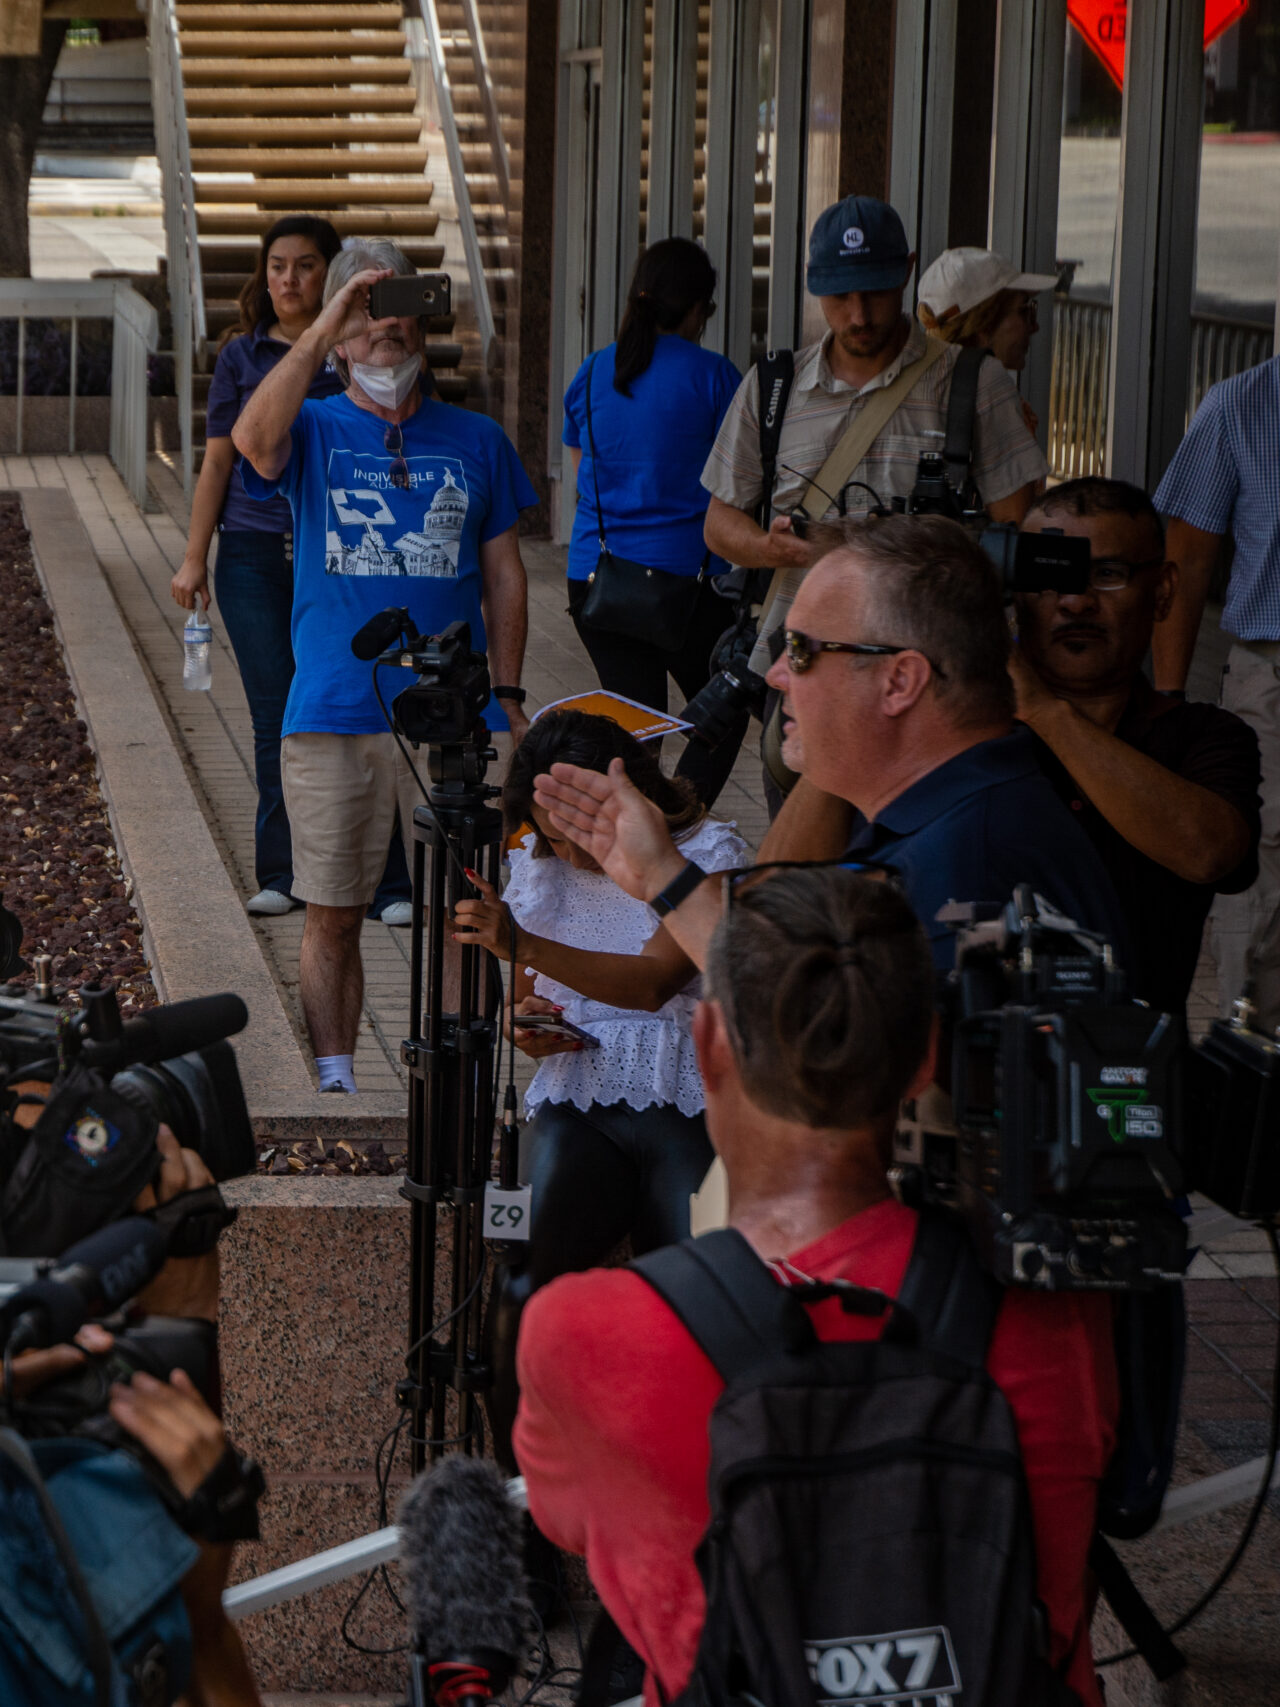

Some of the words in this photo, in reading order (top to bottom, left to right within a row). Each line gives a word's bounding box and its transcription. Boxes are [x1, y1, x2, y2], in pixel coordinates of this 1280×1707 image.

[764, 378, 784, 429] Canon
[353, 467, 436, 482] INDIVISBLE
[368, 481, 419, 490] AUSTN
